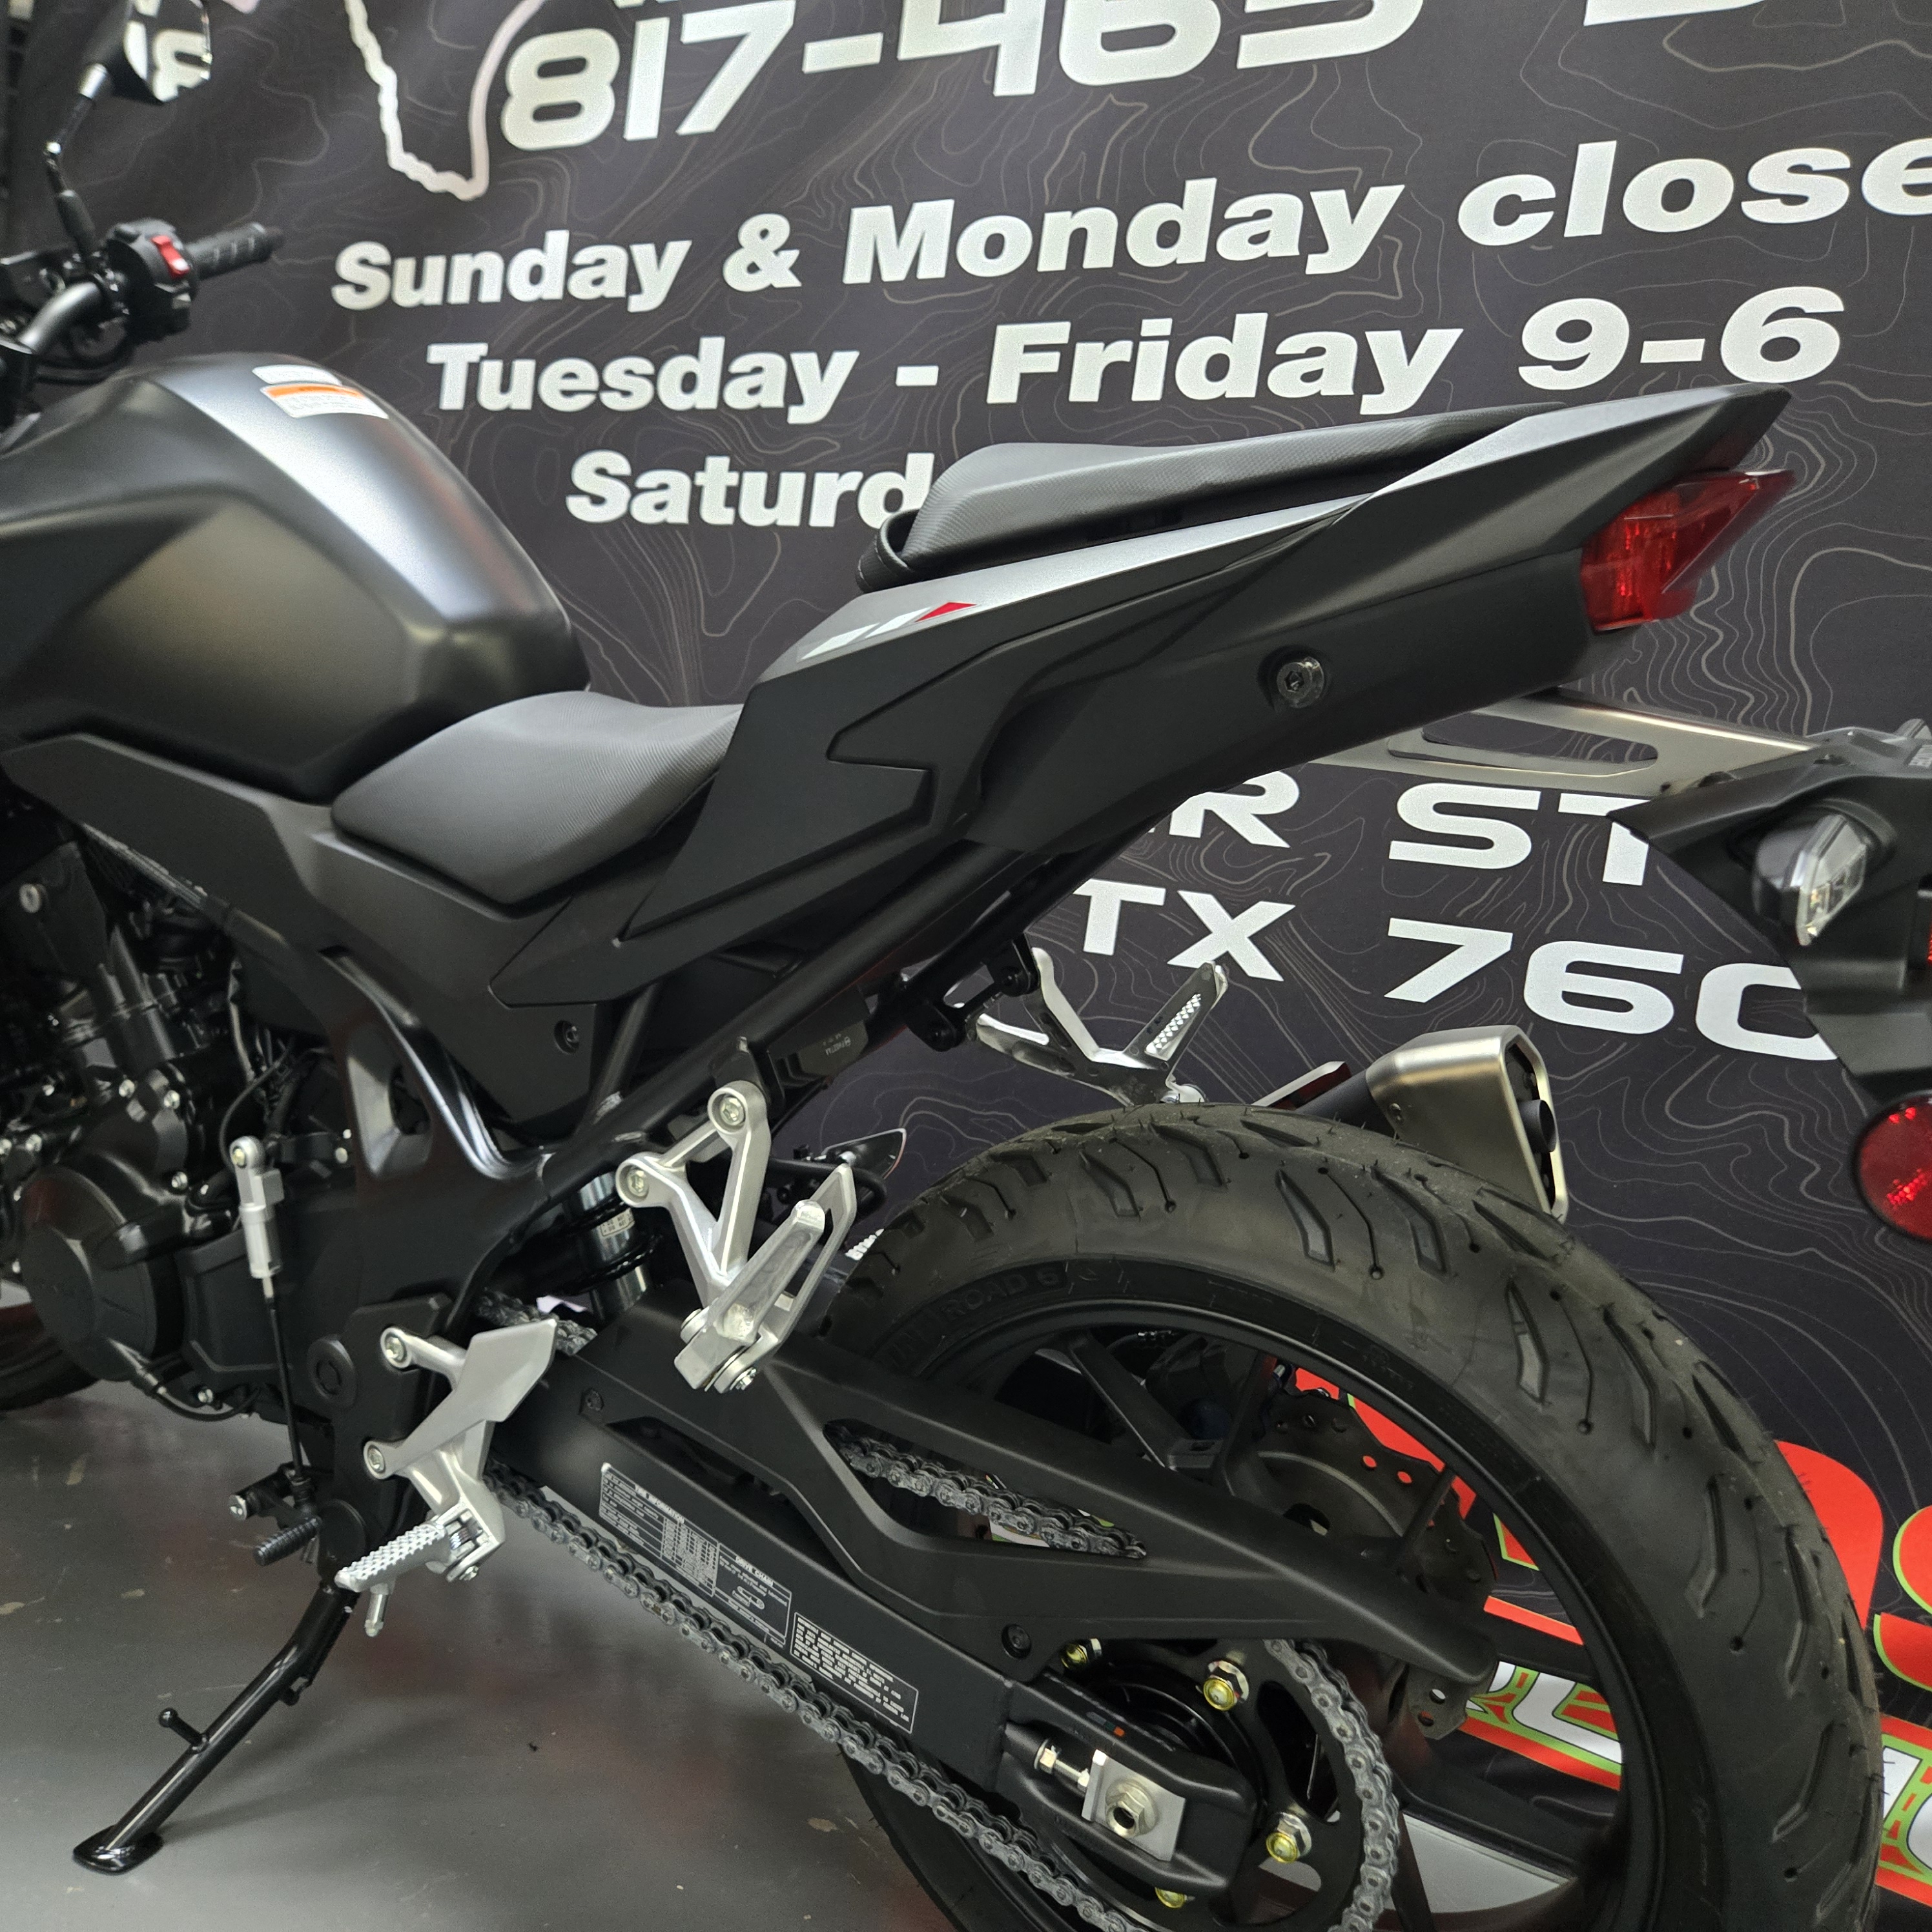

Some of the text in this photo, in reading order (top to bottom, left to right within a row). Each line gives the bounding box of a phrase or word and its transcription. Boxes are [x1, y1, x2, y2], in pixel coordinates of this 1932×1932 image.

[331, 229, 692, 313] Sunday
[723, 213, 802, 293] &
[842, 177, 1406, 285] Monday
[426, 285, 1845, 426] Tuesday - Friday 9-6
[566, 449, 935, 529] Saturd
[1073, 878, 1297, 982] TX
